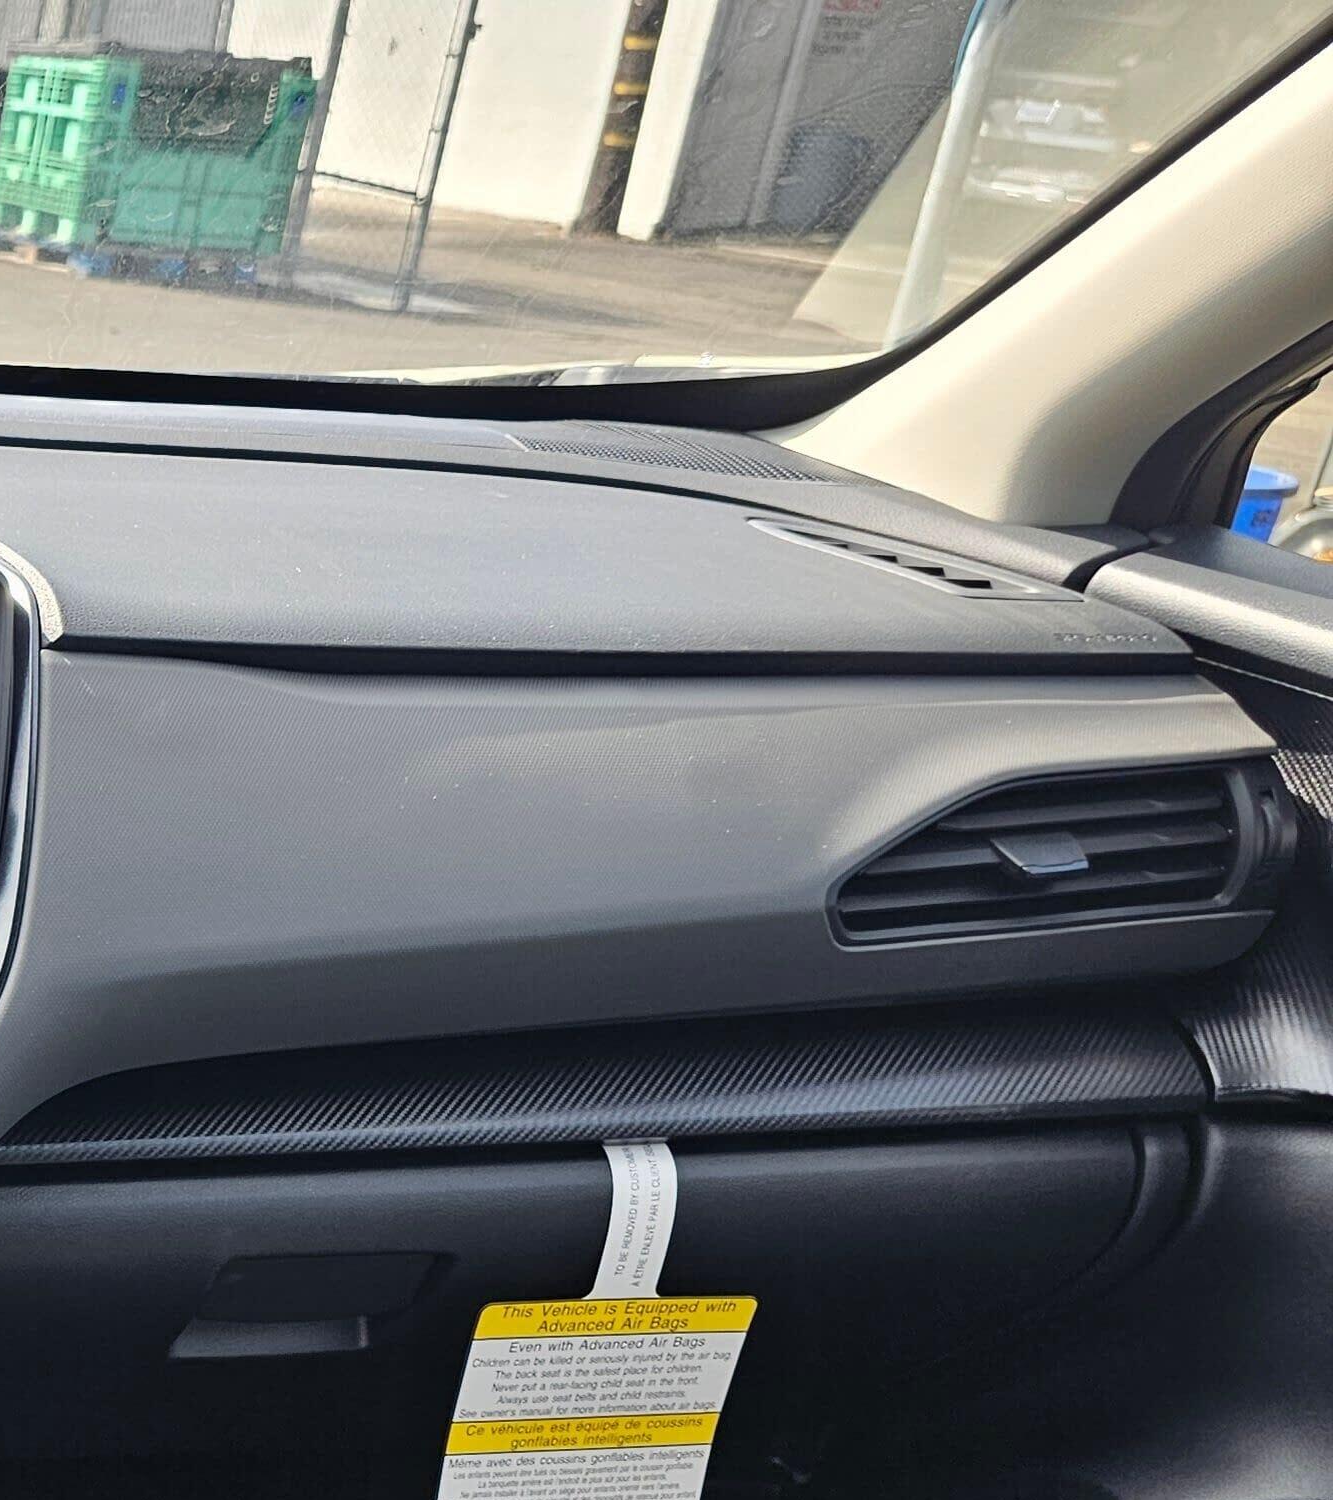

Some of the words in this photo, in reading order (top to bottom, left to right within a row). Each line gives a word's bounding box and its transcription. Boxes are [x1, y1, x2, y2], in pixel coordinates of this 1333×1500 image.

[502, 1306, 534, 1318] This
[542, 1304, 597, 1317] Vehicle
[604, 1304, 617, 1315] is
[625, 1301, 700, 1317] Equipped
[705, 1301, 737, 1313] with
[537, 1318, 614, 1333] Advanced
[621, 1318, 643, 1330] Air
[649, 1316, 689, 1332] Bags
[509, 1341, 542, 1354] Even
[548, 1340, 574, 1352] with
[579, 1338, 645, 1351] Advanced
[649, 1337, 668, 1348] Air
[673, 1336, 707, 1350] Bags
[466, 1424, 486, 1437] Ce
[549, 1422, 571, 1433] est
[624, 1419, 641, 1430] de
[646, 1417, 703, 1429] coussins
